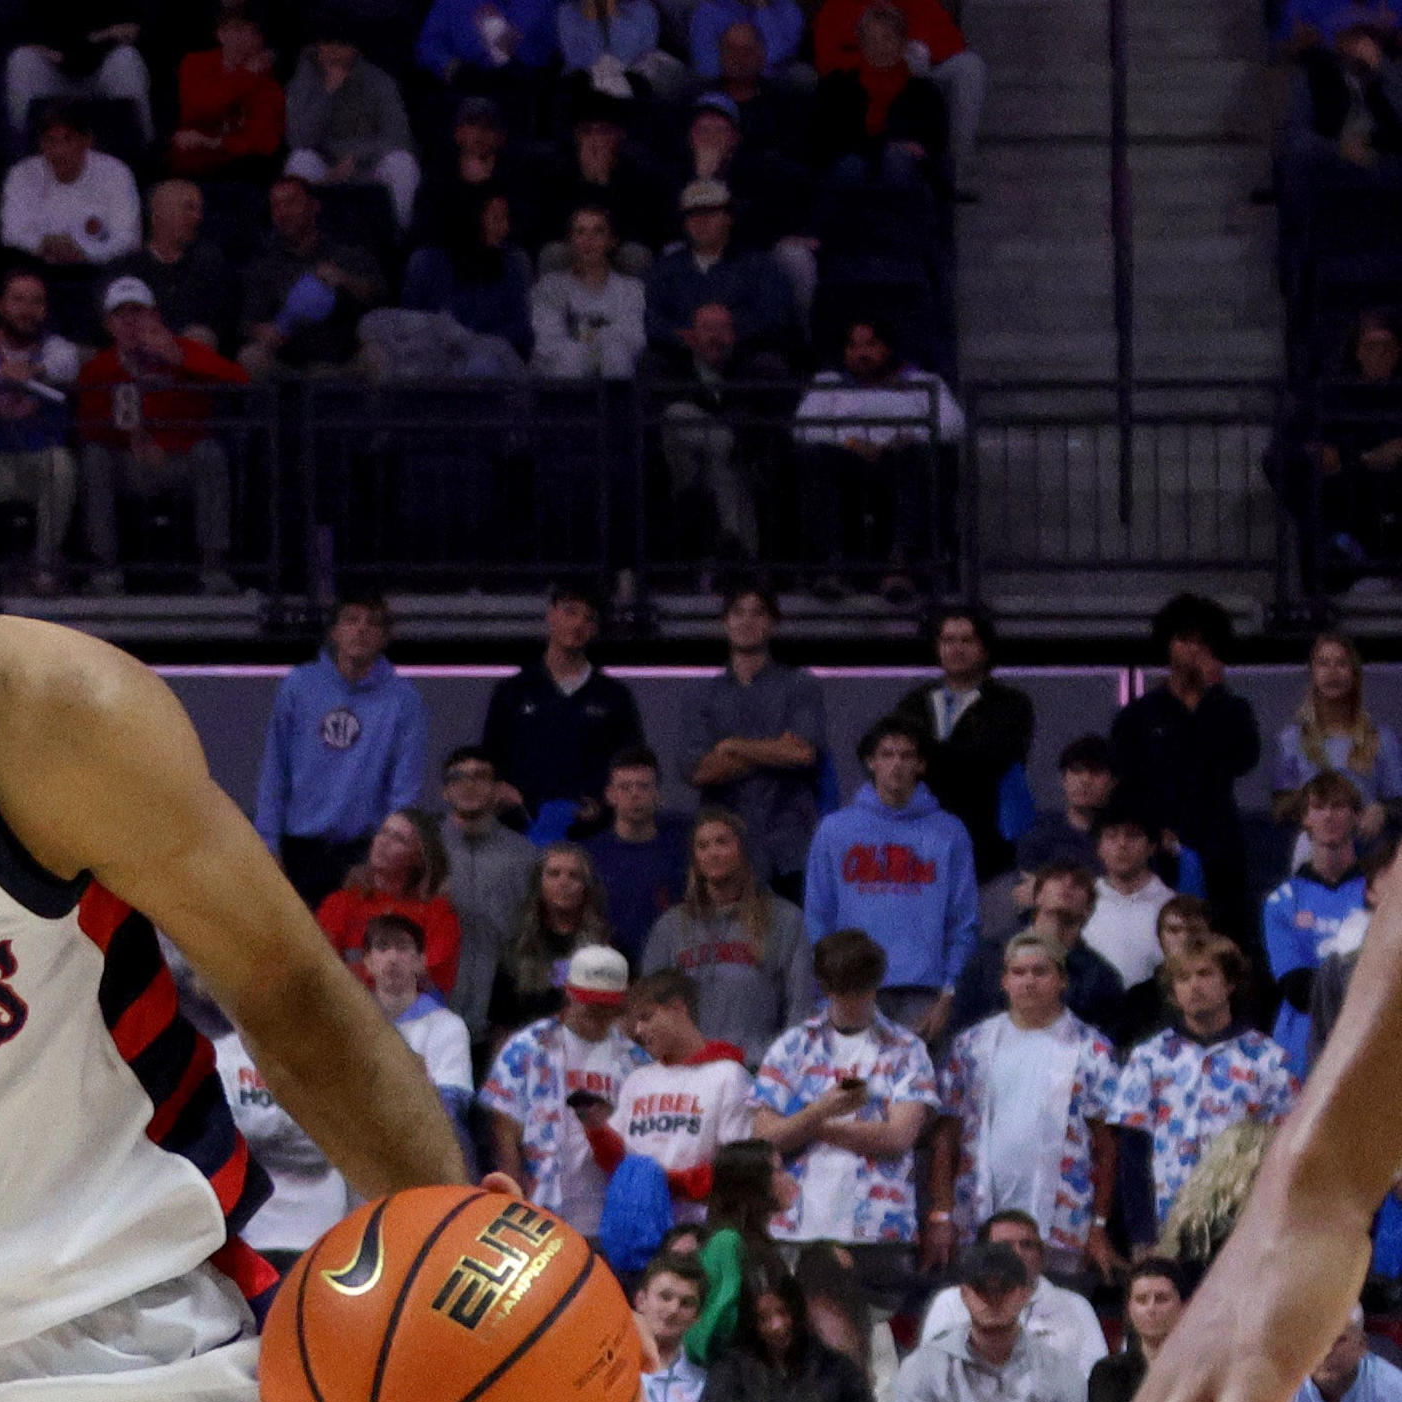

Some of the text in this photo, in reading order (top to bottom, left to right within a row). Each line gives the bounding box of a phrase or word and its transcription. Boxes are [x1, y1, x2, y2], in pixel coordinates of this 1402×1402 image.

[628, 1114, 702, 1136] HOOPS
[630, 1092, 704, 1117] REBEL
[430, 1201, 557, 1331] ELITE
[492, 1237, 565, 1326] AMPIONS
